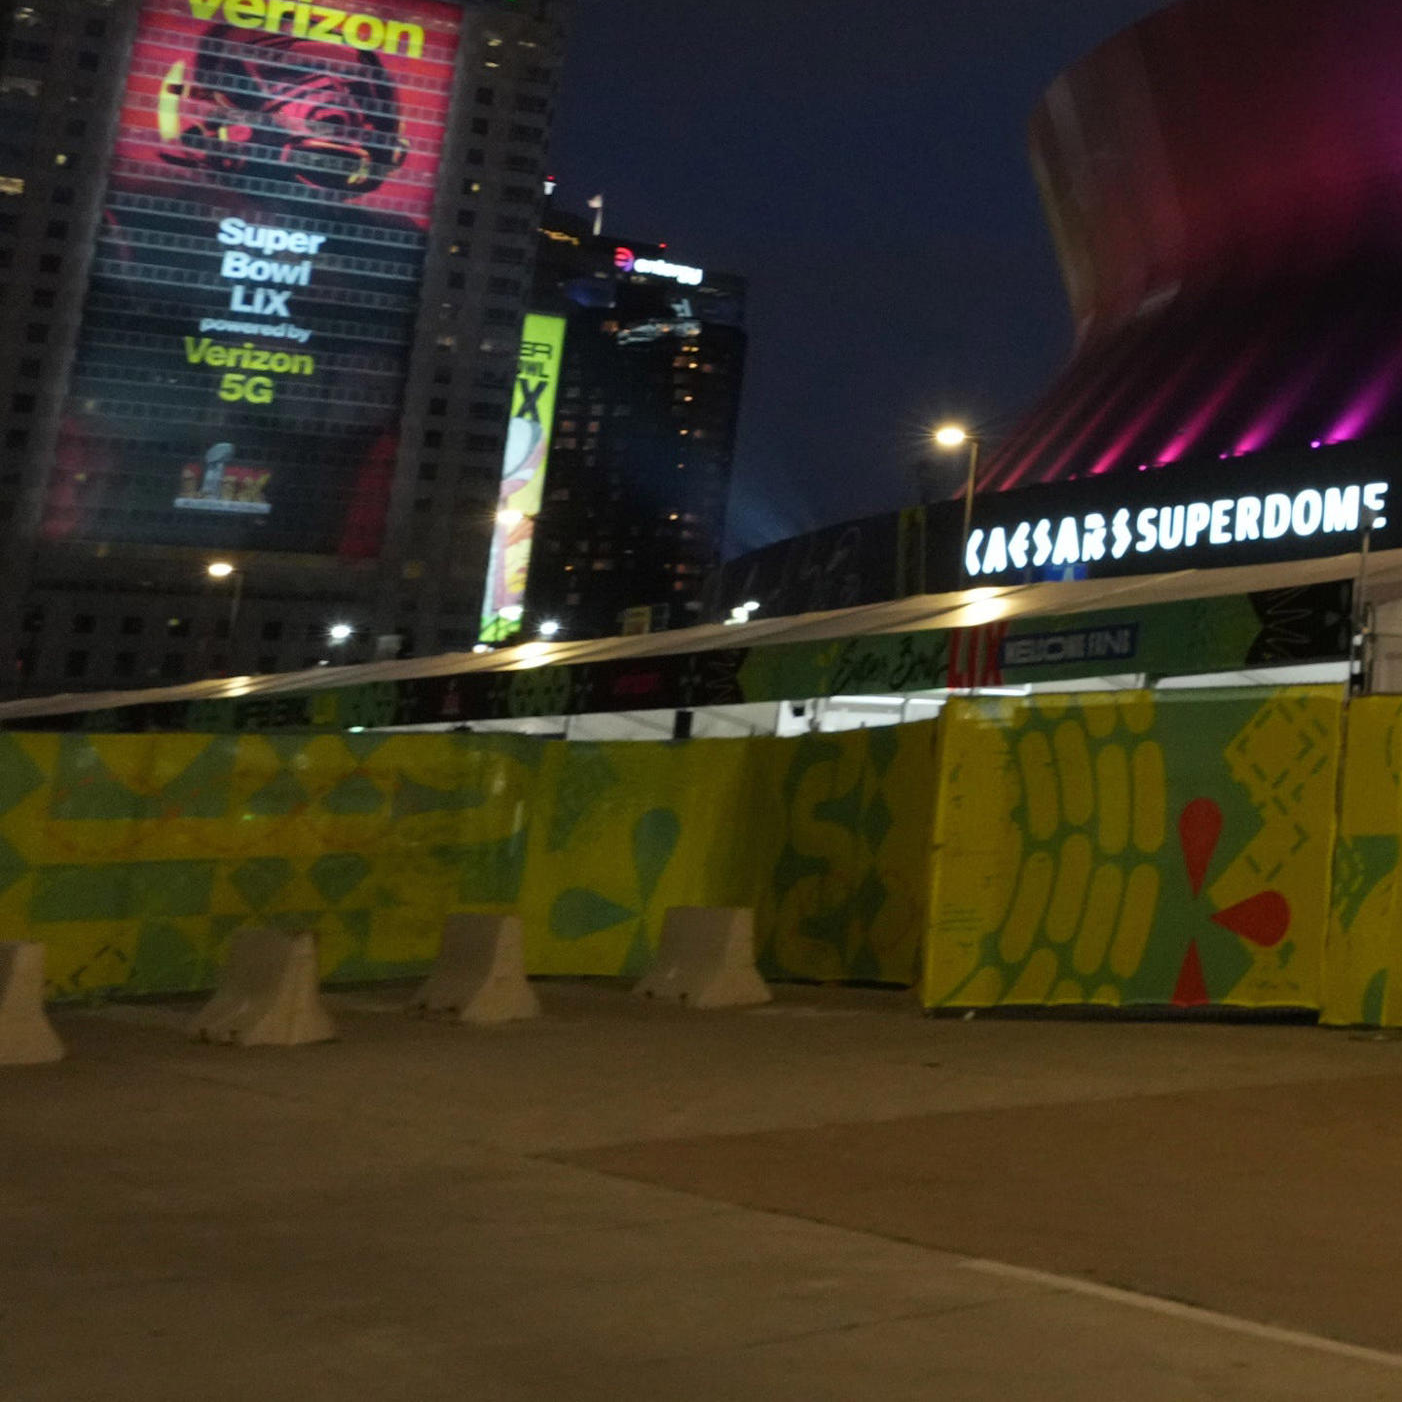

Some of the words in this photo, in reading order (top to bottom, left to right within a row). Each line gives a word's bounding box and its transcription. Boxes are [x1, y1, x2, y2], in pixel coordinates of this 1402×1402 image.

[217, 217, 327, 255] Super
[220, 250, 313, 286] Bowl
[230, 285, 293, 318] LIX
[199, 318, 287, 338] powered
[286, 323, 312, 343] by
[184, 336, 315, 376] Verizon
[218, 372, 275, 404] 5G
[964, 506, 1134, 577] CAESARS
[1135, 481, 1389, 554] SUPERDOME
